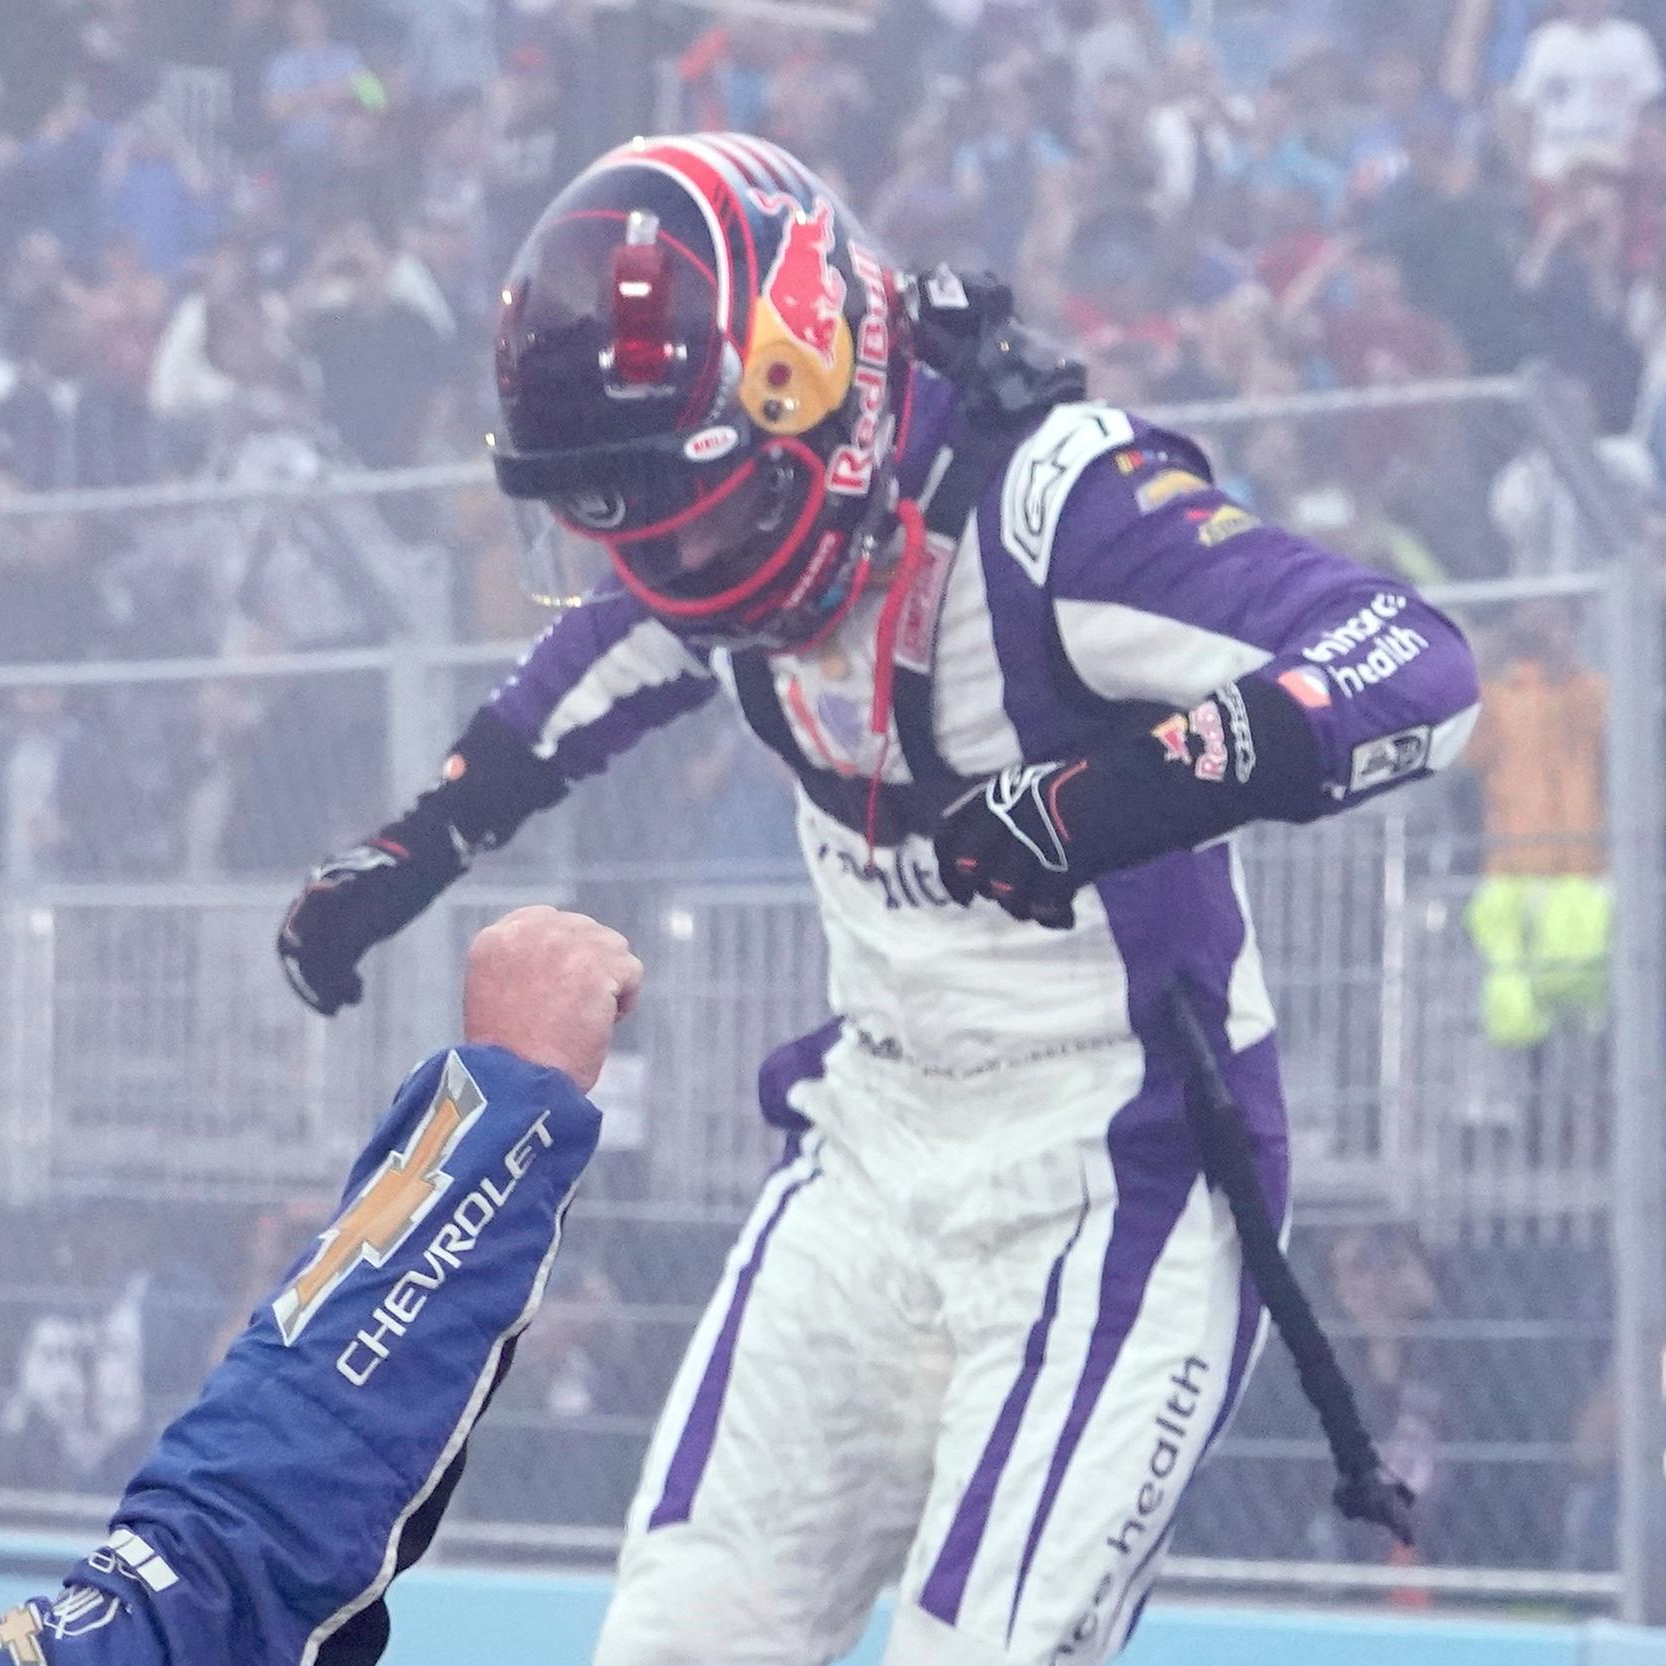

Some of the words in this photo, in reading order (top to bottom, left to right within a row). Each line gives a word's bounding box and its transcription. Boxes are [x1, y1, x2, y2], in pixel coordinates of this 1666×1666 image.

[827, 370, 889, 496] Red
[1327, 625, 1430, 699] health
[335, 1109, 551, 1387] CHEVROLET
[1108, 1354, 1211, 1554] health
